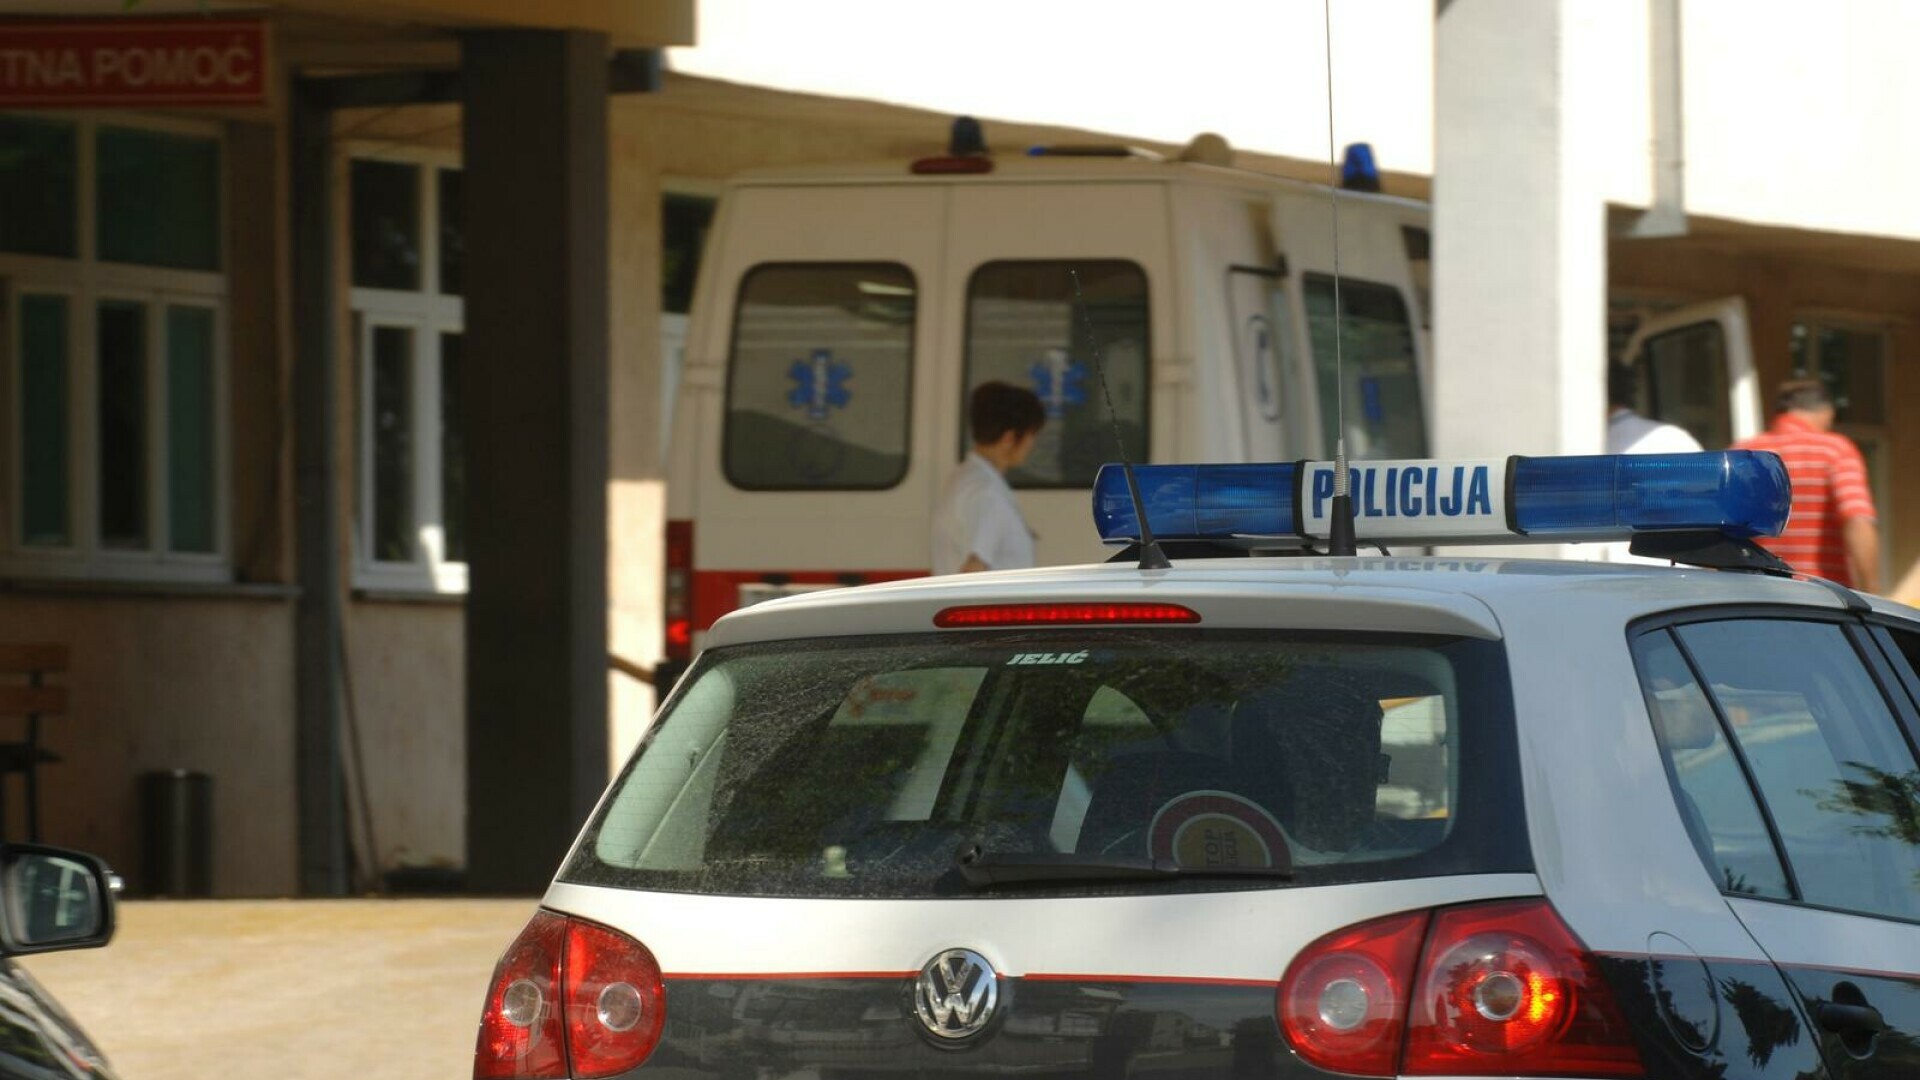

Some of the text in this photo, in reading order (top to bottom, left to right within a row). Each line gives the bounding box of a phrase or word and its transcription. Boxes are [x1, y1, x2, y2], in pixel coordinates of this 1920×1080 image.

[94, 34, 254, 87] POMOĆ
[1006, 649, 1089, 665] JELIĆ
[1204, 829, 1220, 868] TOP
